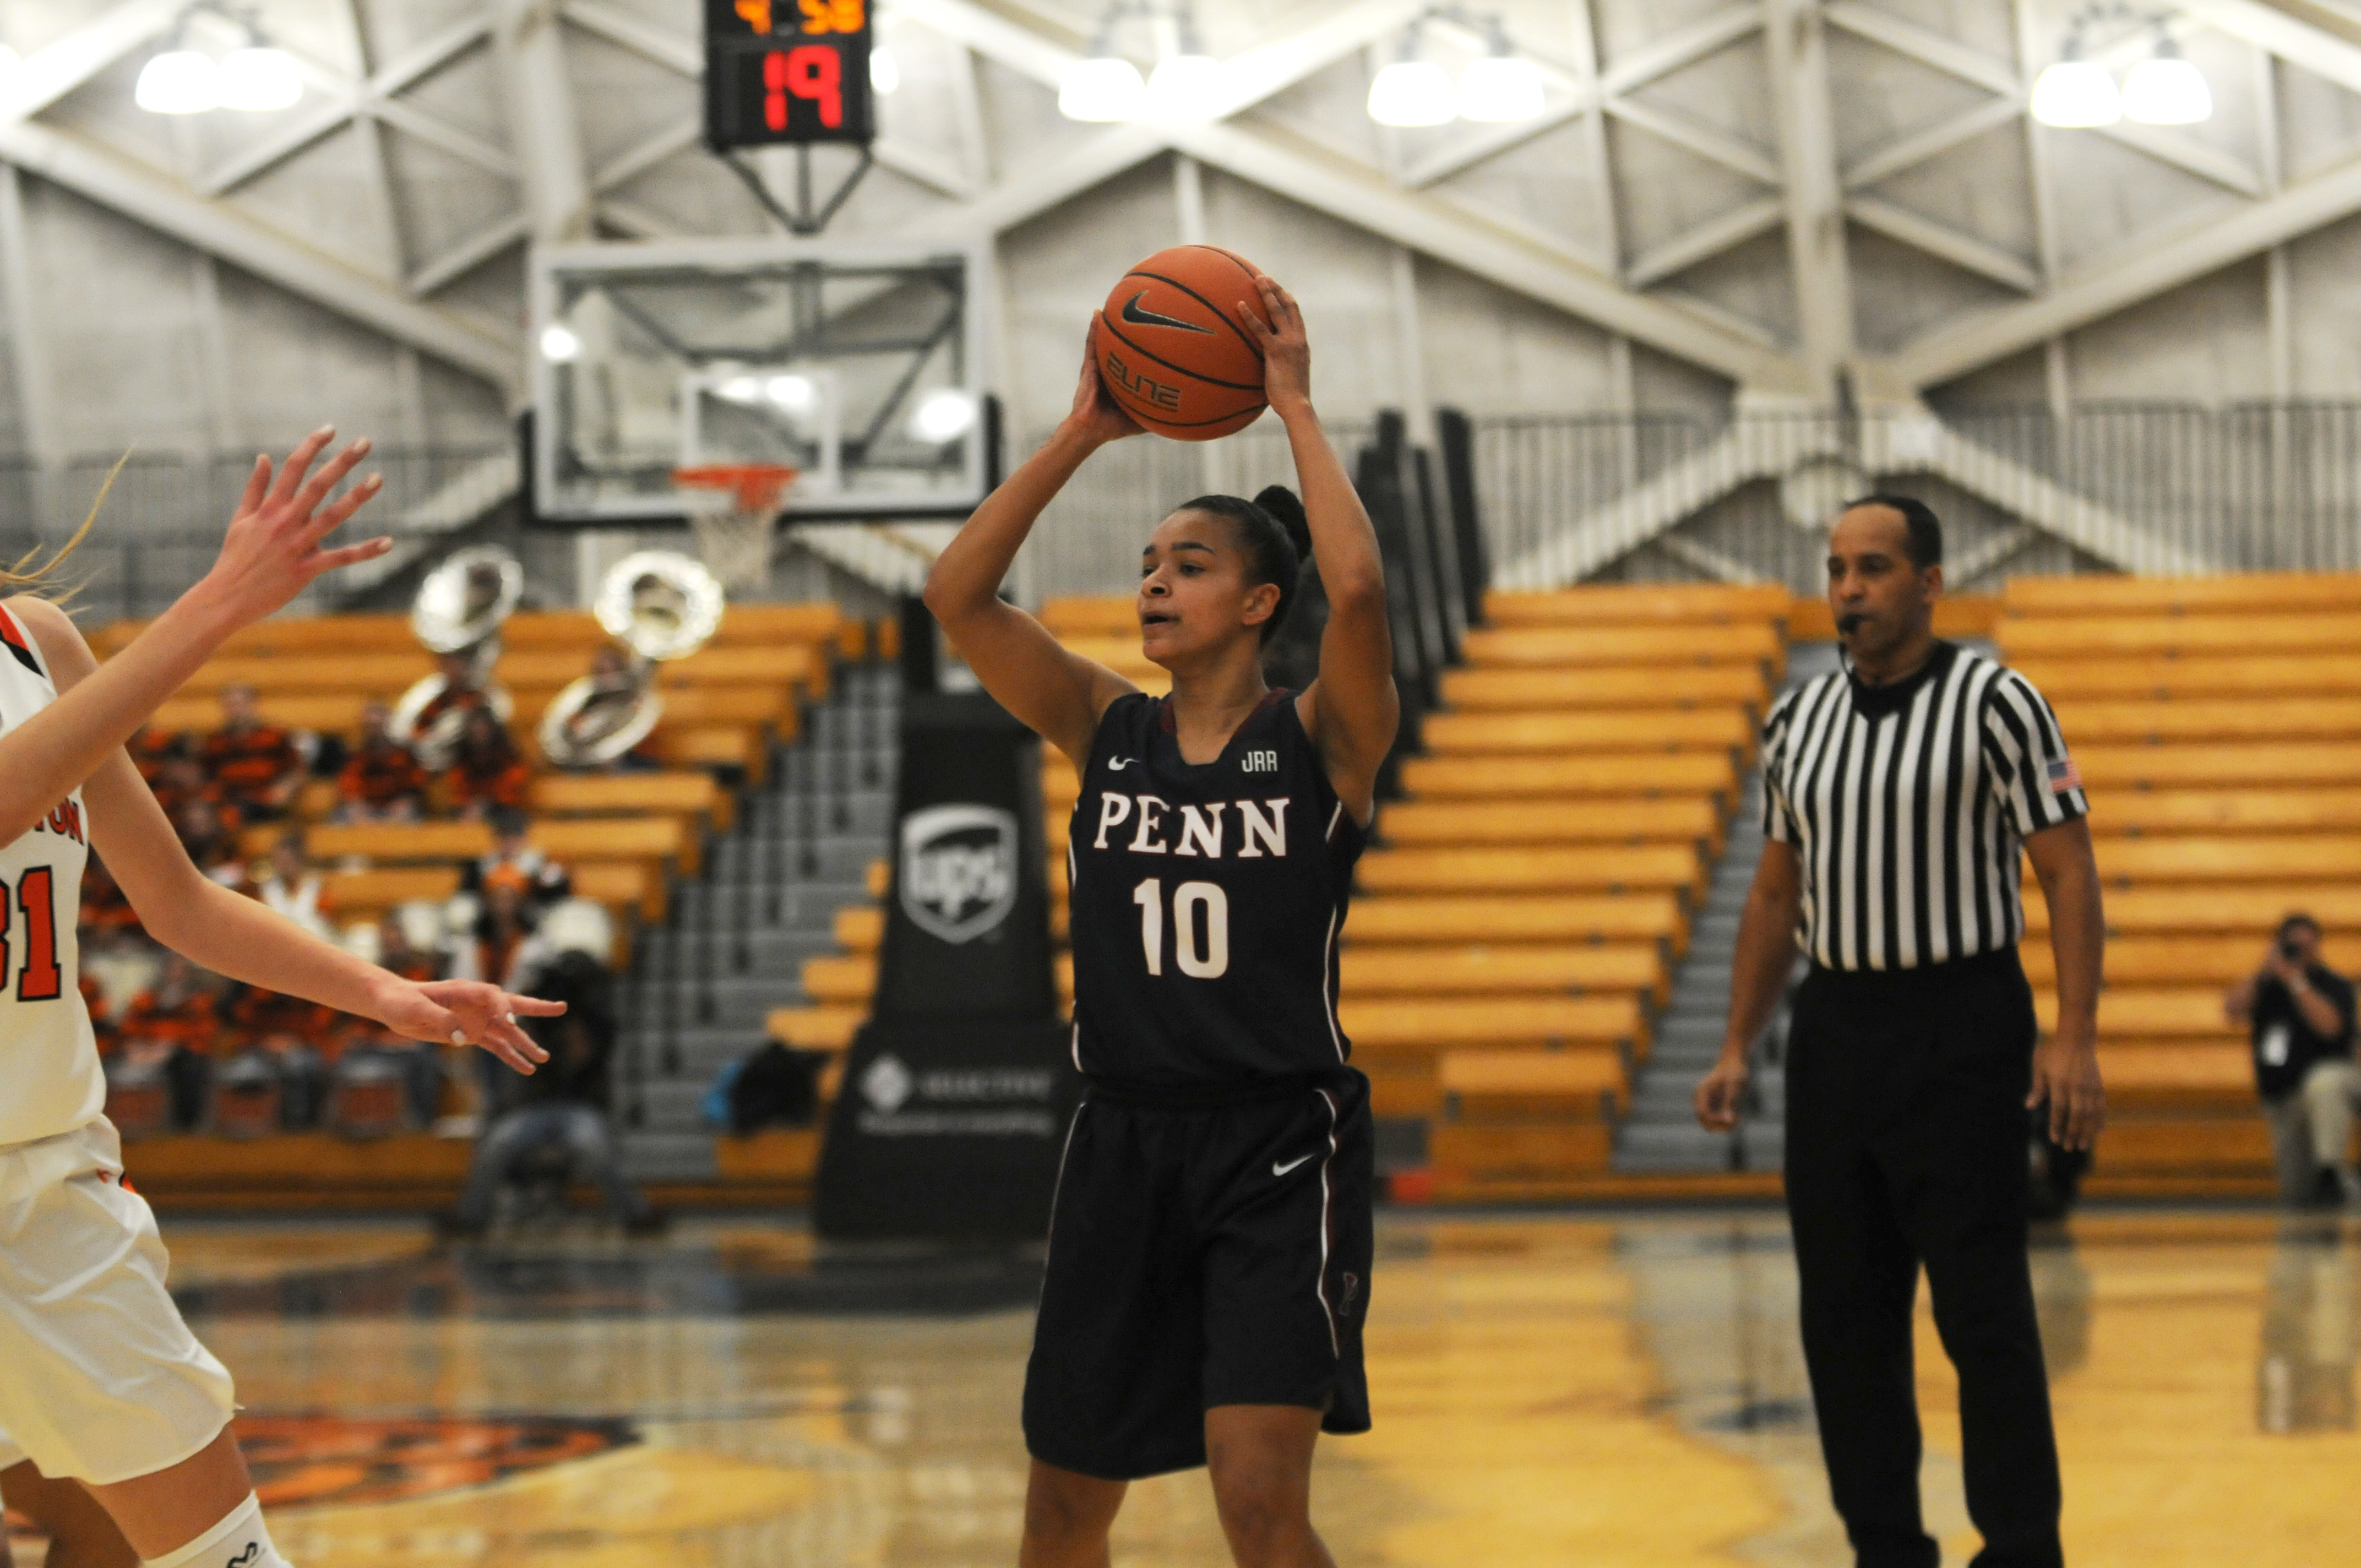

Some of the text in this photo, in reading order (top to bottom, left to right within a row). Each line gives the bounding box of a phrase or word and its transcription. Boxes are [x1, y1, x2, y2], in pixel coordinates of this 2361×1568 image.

[764, 44, 842, 130] 19
[1107, 351, 1181, 407] ELITE
[1094, 792, 1290, 858] PENN
[1134, 878, 1228, 978] 10
